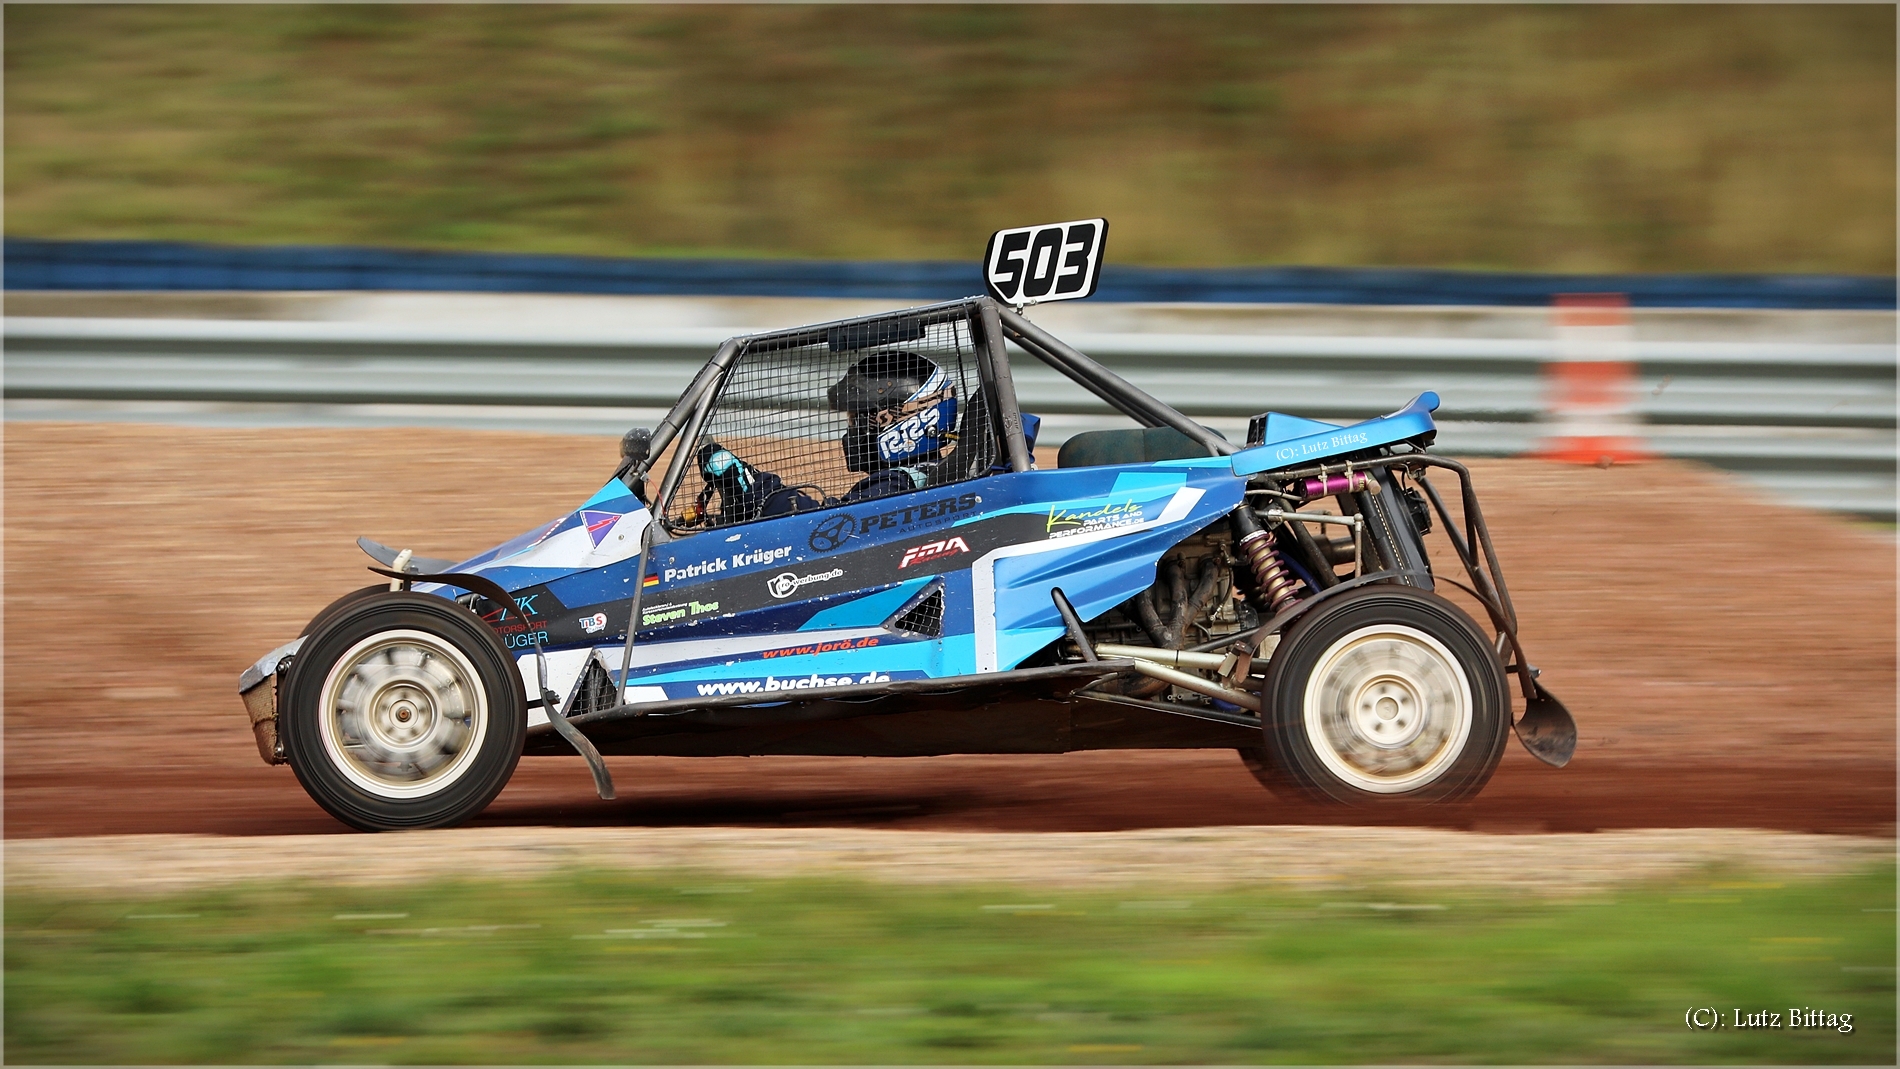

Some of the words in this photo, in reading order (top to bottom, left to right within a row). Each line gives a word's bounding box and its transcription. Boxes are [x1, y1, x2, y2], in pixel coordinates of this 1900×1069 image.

[993, 223, 1096, 299] 503
[859, 492, 977, 534] PETERS
[899, 510, 978, 534] AUTOSPORT
[1046, 498, 1143, 533] Kandels
[1083, 514, 1120, 527] PARTS
[1122, 510, 1143, 519] AND
[664, 558, 728, 583] Patrick
[732, 545, 792, 568] Krüger
[642, 607, 686, 626] Steven
[689, 601, 719, 616] Thos
[493, 620, 548, 634] OTORSORT
[504, 631, 549, 649] ÜGER
[762, 637, 879, 659] www.jorö.de
[696, 670, 891, 697] www.buchse.de
